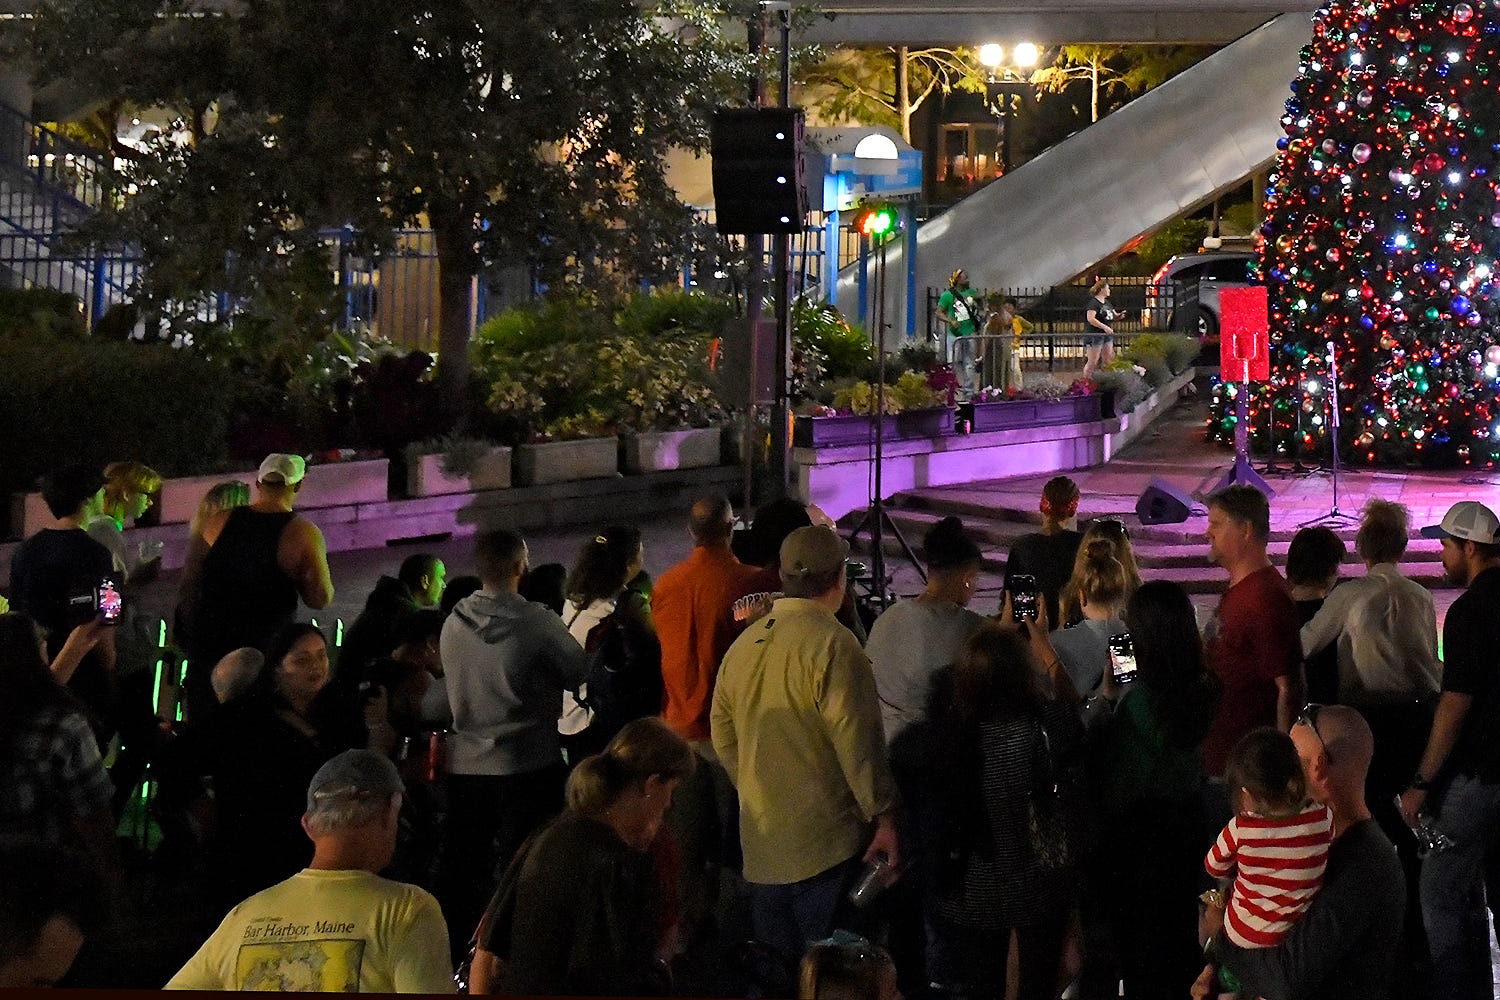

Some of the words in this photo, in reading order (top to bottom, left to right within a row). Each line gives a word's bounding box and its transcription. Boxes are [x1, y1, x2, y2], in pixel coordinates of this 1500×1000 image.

[243, 925, 263, 938] Bar
[263, 923, 310, 937] Harbor,
[313, 921, 355, 934] Maine
